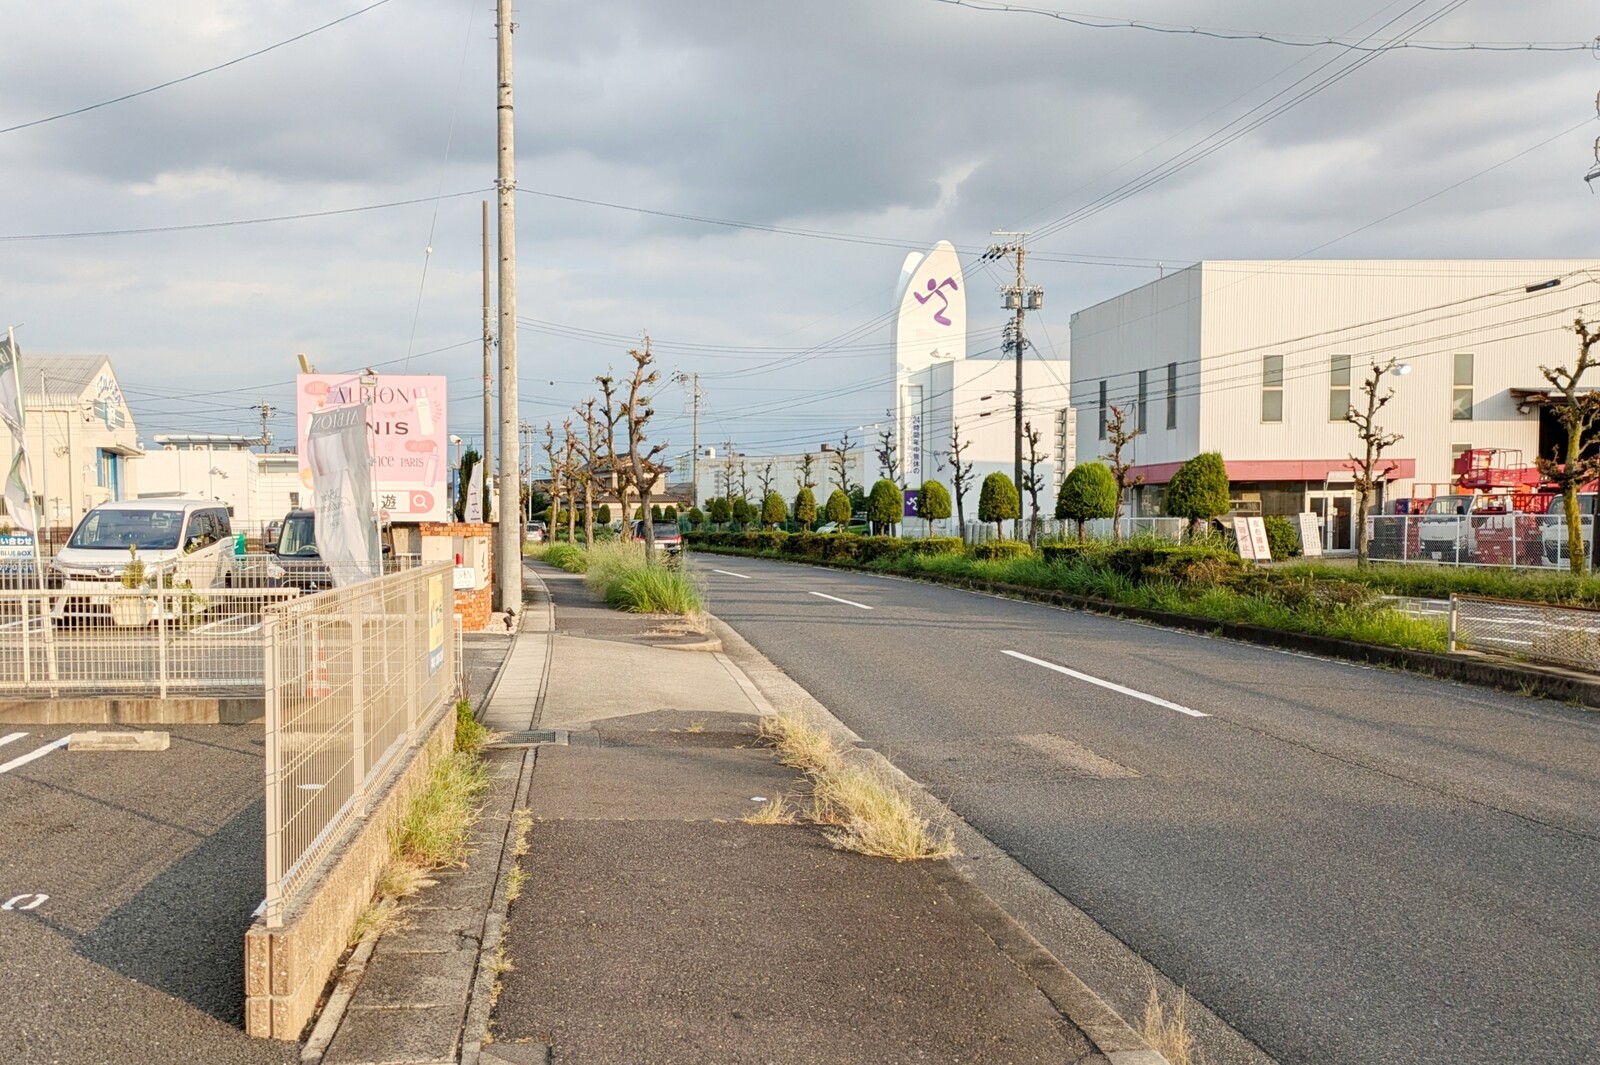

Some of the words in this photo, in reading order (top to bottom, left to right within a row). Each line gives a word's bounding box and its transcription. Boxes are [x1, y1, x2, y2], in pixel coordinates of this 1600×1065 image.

[334, 386, 409, 404] ALBION
[401, 457, 424, 467] PARIS
[381, 494, 397, 510] 遊
[1253, 520, 1265, 553] 左右確認
